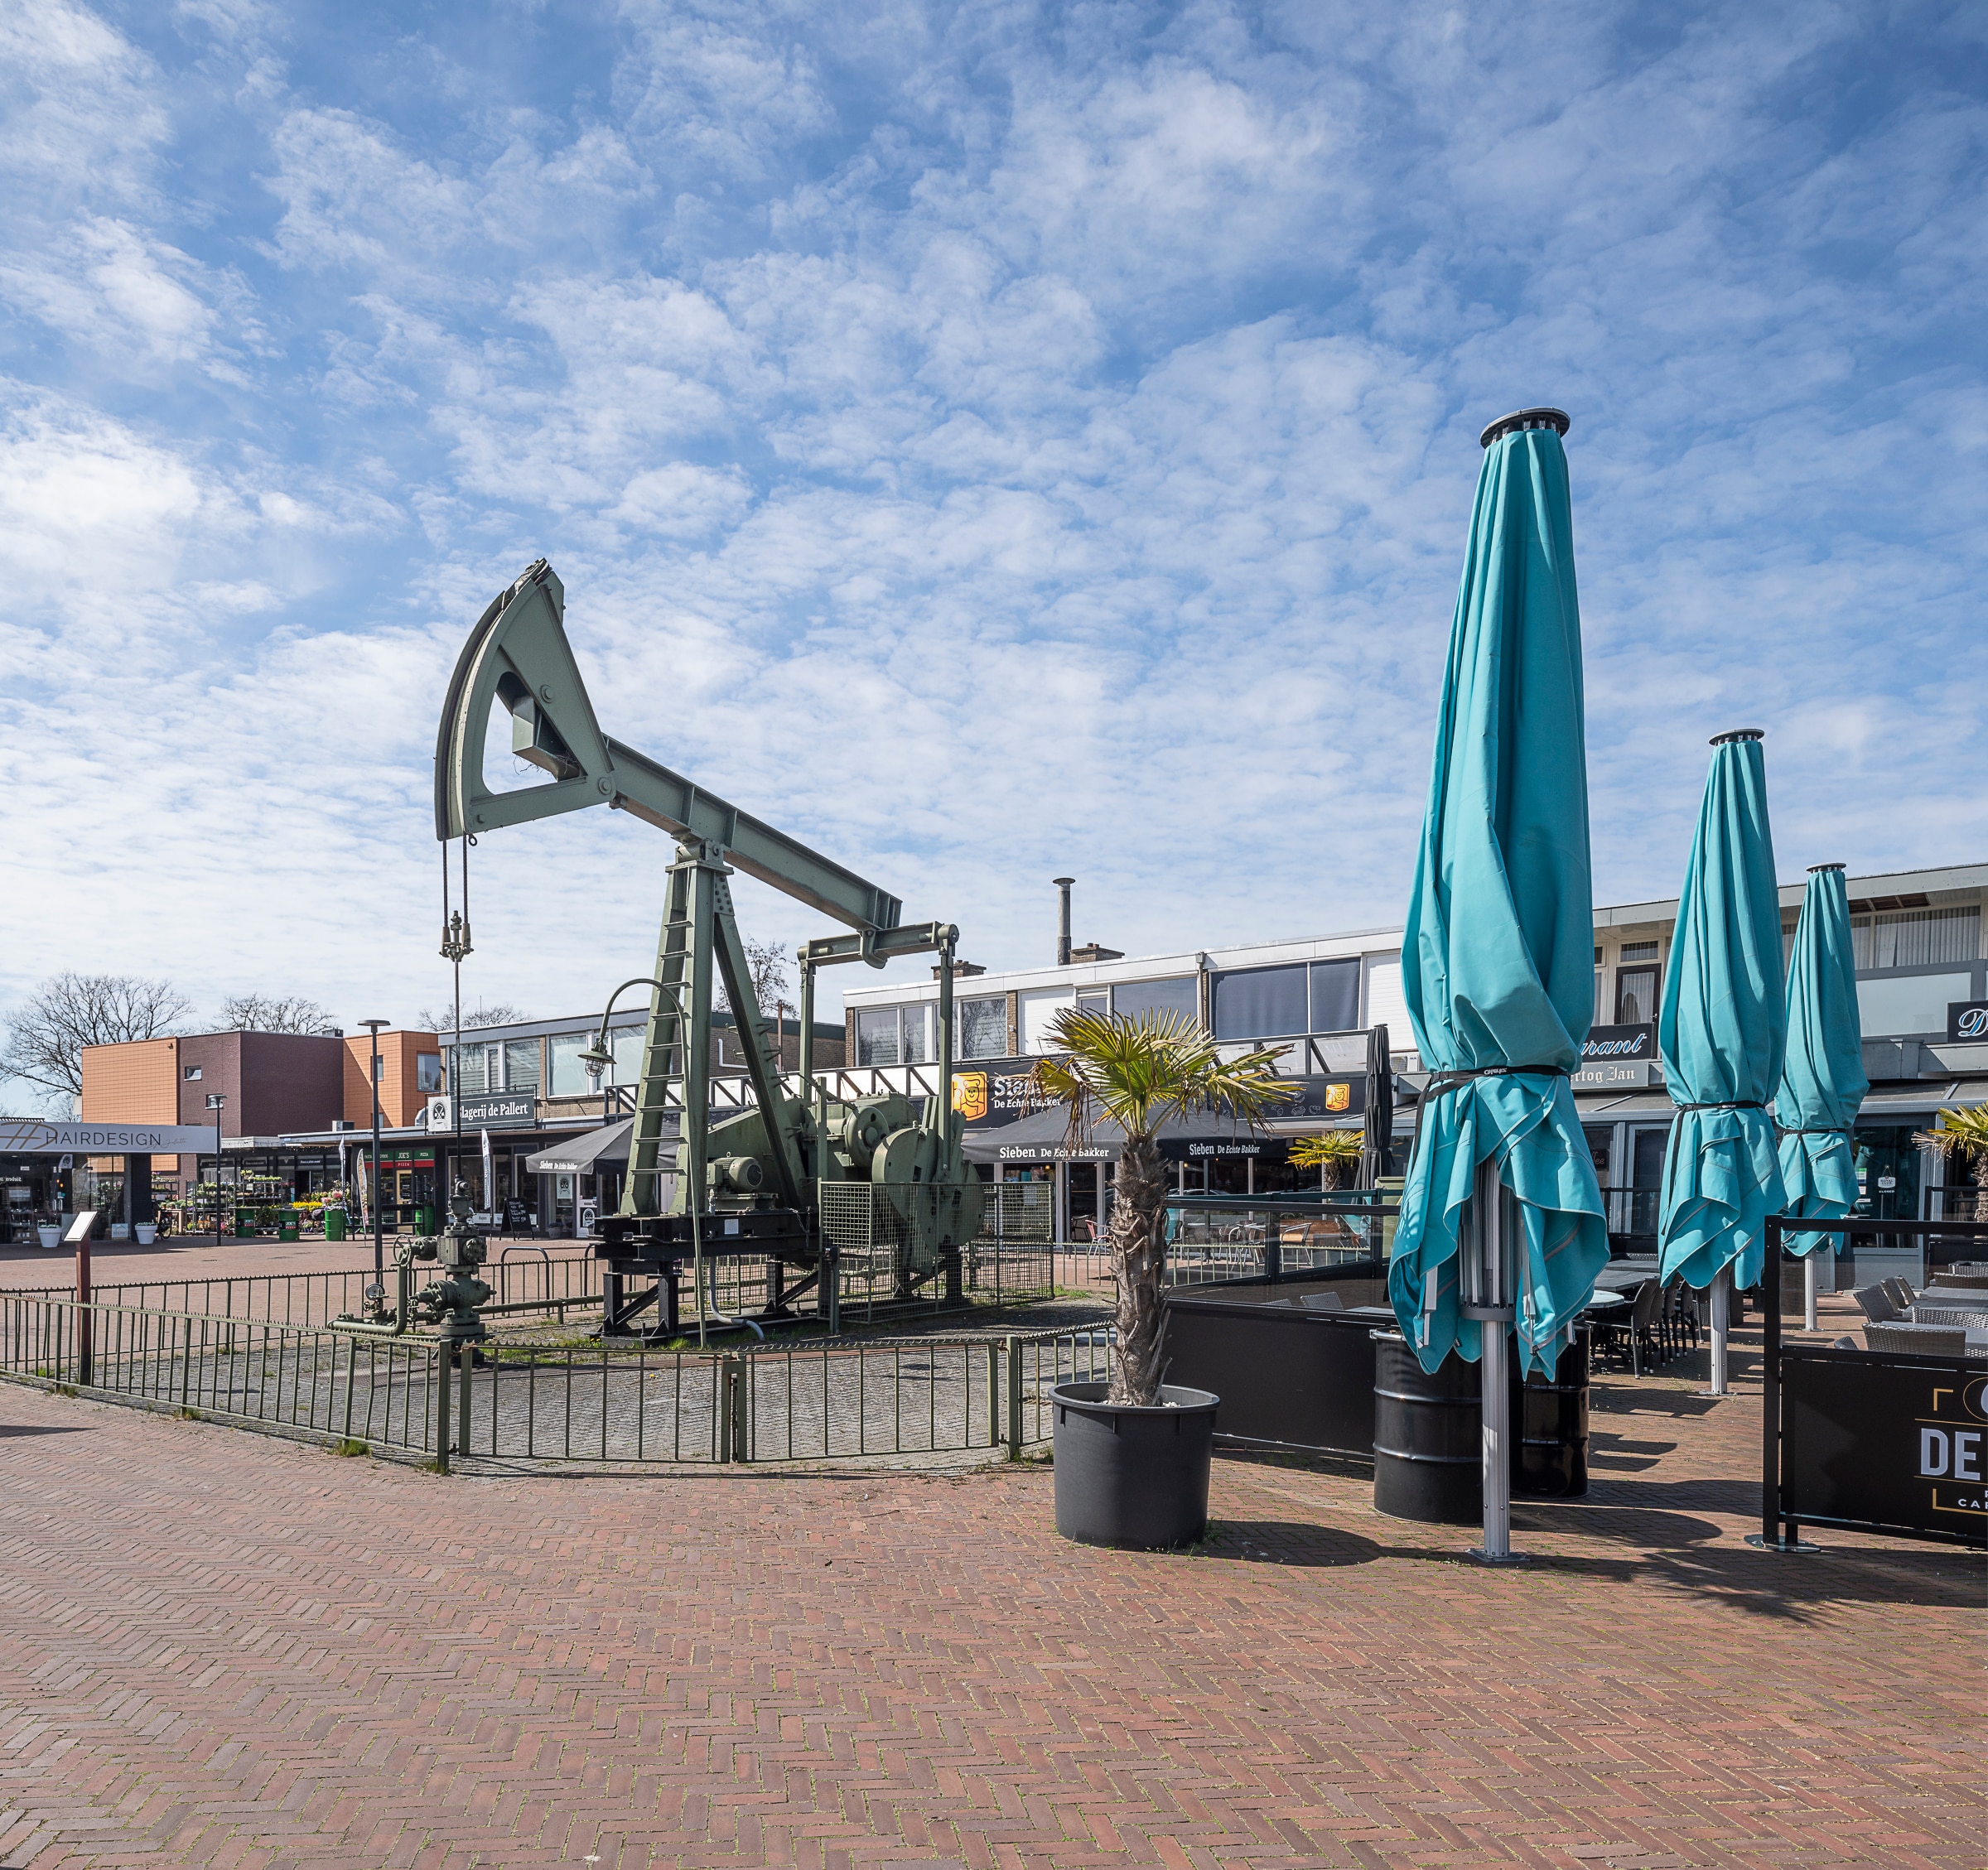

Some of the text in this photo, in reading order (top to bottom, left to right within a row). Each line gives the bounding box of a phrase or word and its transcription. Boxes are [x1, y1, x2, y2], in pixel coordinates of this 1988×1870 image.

[1957, 1008, 1988, 1037] D
[1605, 1066, 1635, 1084] Jan
[488, 1104, 499, 1116] de
[499, 1101, 528, 1116] Pallert
[994, 1100, 1006, 1108] De
[46, 1130, 161, 1146] HAIRDESIGN
[999, 1146, 1036, 1159] Sieben
[1040, 1148, 1052, 1158] De
[1189, 1143, 1215, 1156] Sieben
[1217, 1145, 1225, 1154] De
[1241, 1145, 1260, 1154] Bakker
[539, 1160, 553, 1169] Sieben
[1920, 1428, 1981, 1481] DE
